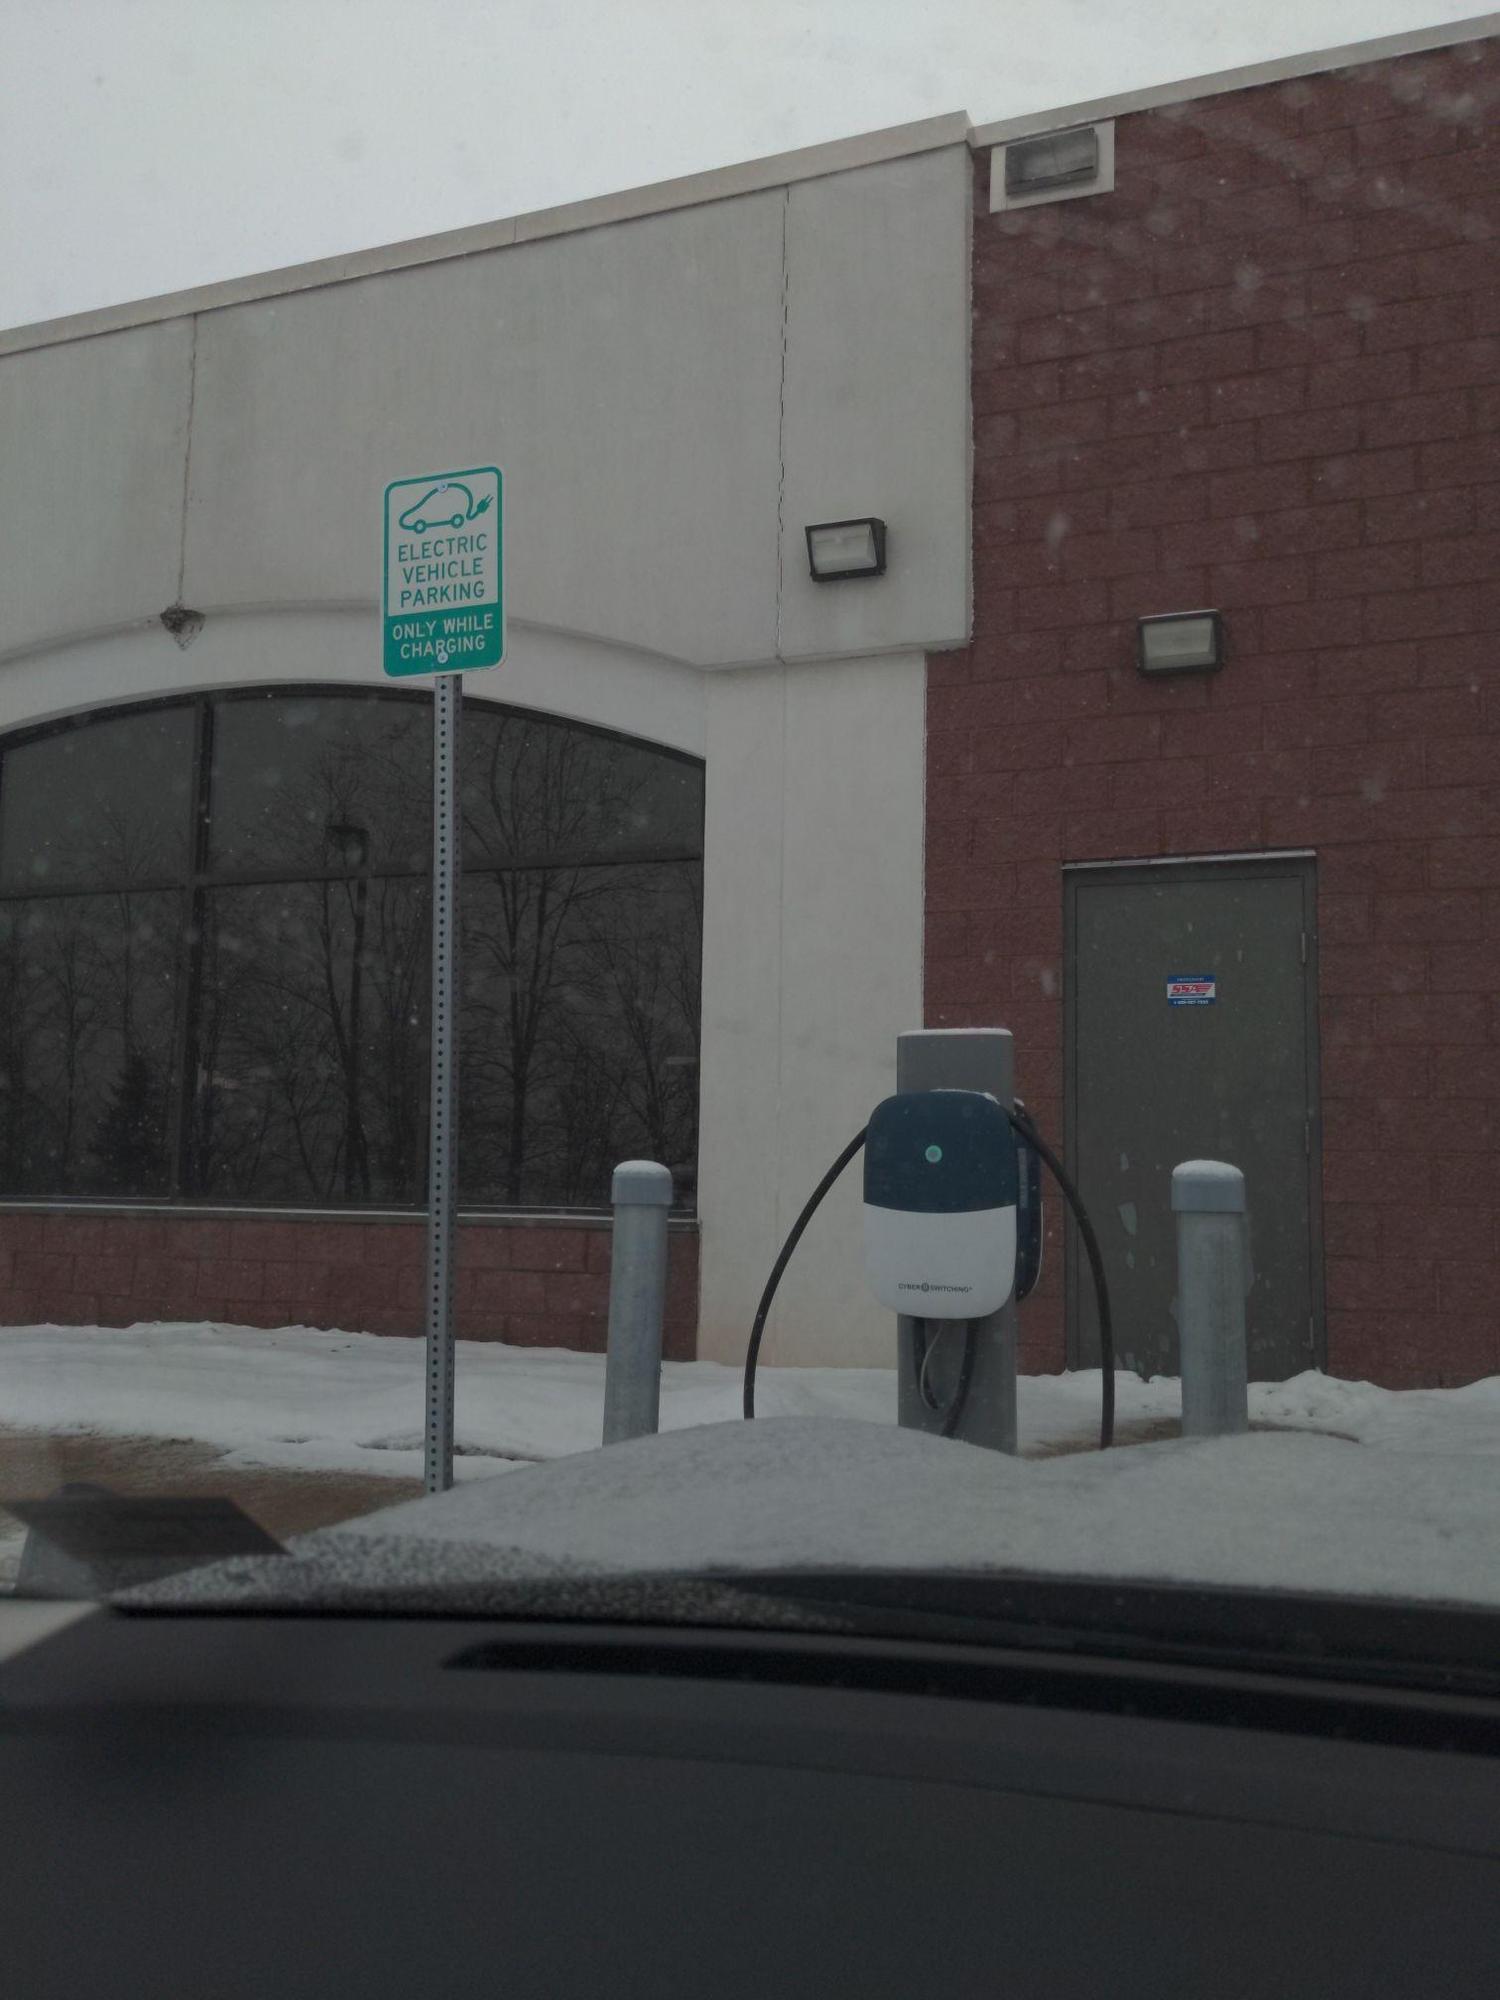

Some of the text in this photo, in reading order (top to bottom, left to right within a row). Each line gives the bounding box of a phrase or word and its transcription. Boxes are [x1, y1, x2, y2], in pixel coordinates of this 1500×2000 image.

[398, 533, 488, 563] ELECTRIC
[402, 557, 484, 585] VEHICLE
[400, 581, 485, 608] PARKING
[392, 613, 494, 641] ONLY WHILE
[400, 635, 485, 659] CHARGING
